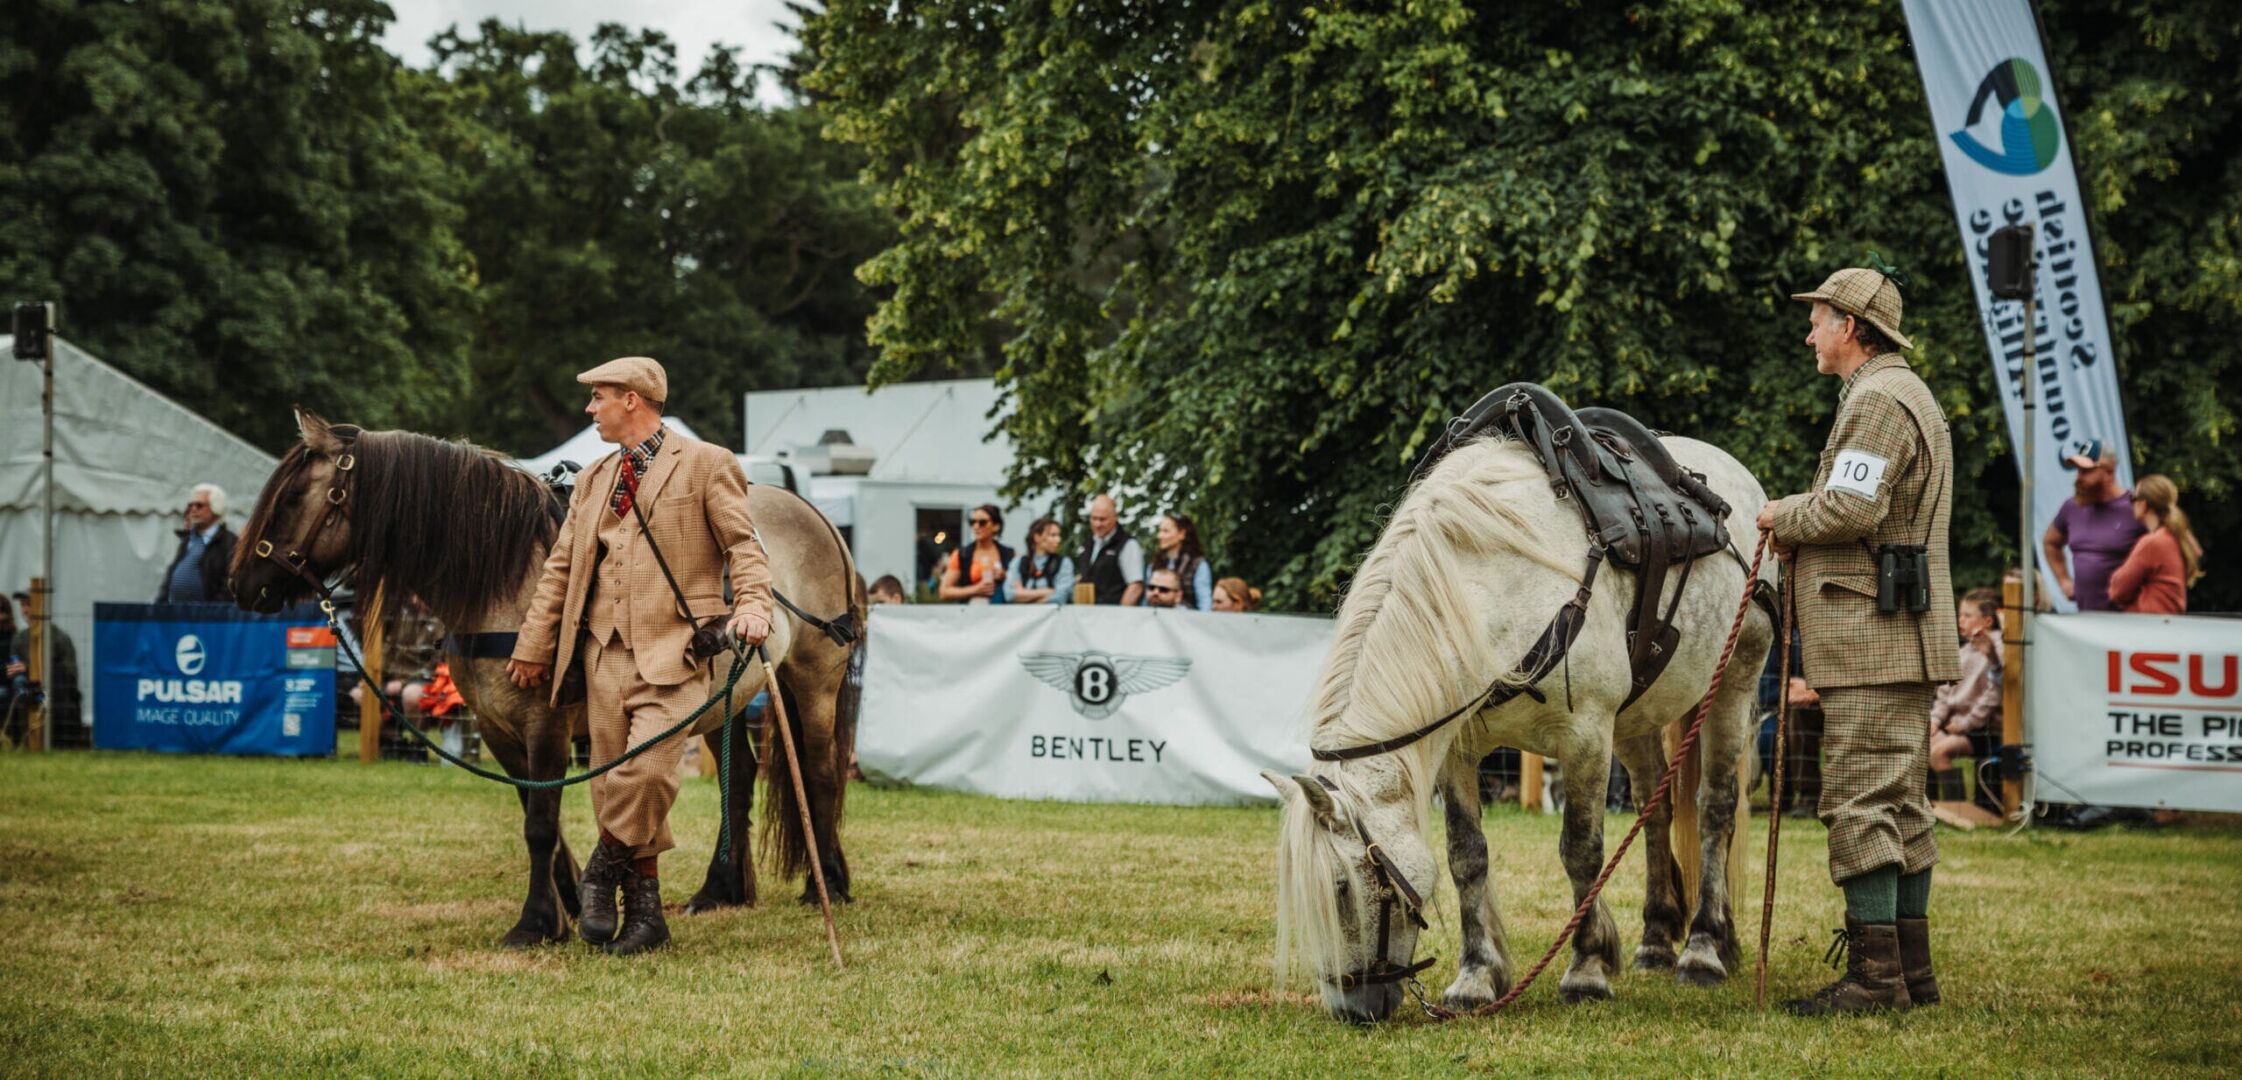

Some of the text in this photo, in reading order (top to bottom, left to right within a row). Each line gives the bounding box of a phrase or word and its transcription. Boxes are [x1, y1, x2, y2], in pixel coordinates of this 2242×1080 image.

[1843, 460, 1869, 482] 10
[2107, 651, 2239, 698] ISU
[137, 679, 242, 704] PULSAR
[136, 708, 240, 726] IMAGE QUALITY
[2107, 712, 2242, 738] THE PI
[1031, 735, 1167, 763] BENTLEY
[2106, 741, 2242, 762] PROFESS
